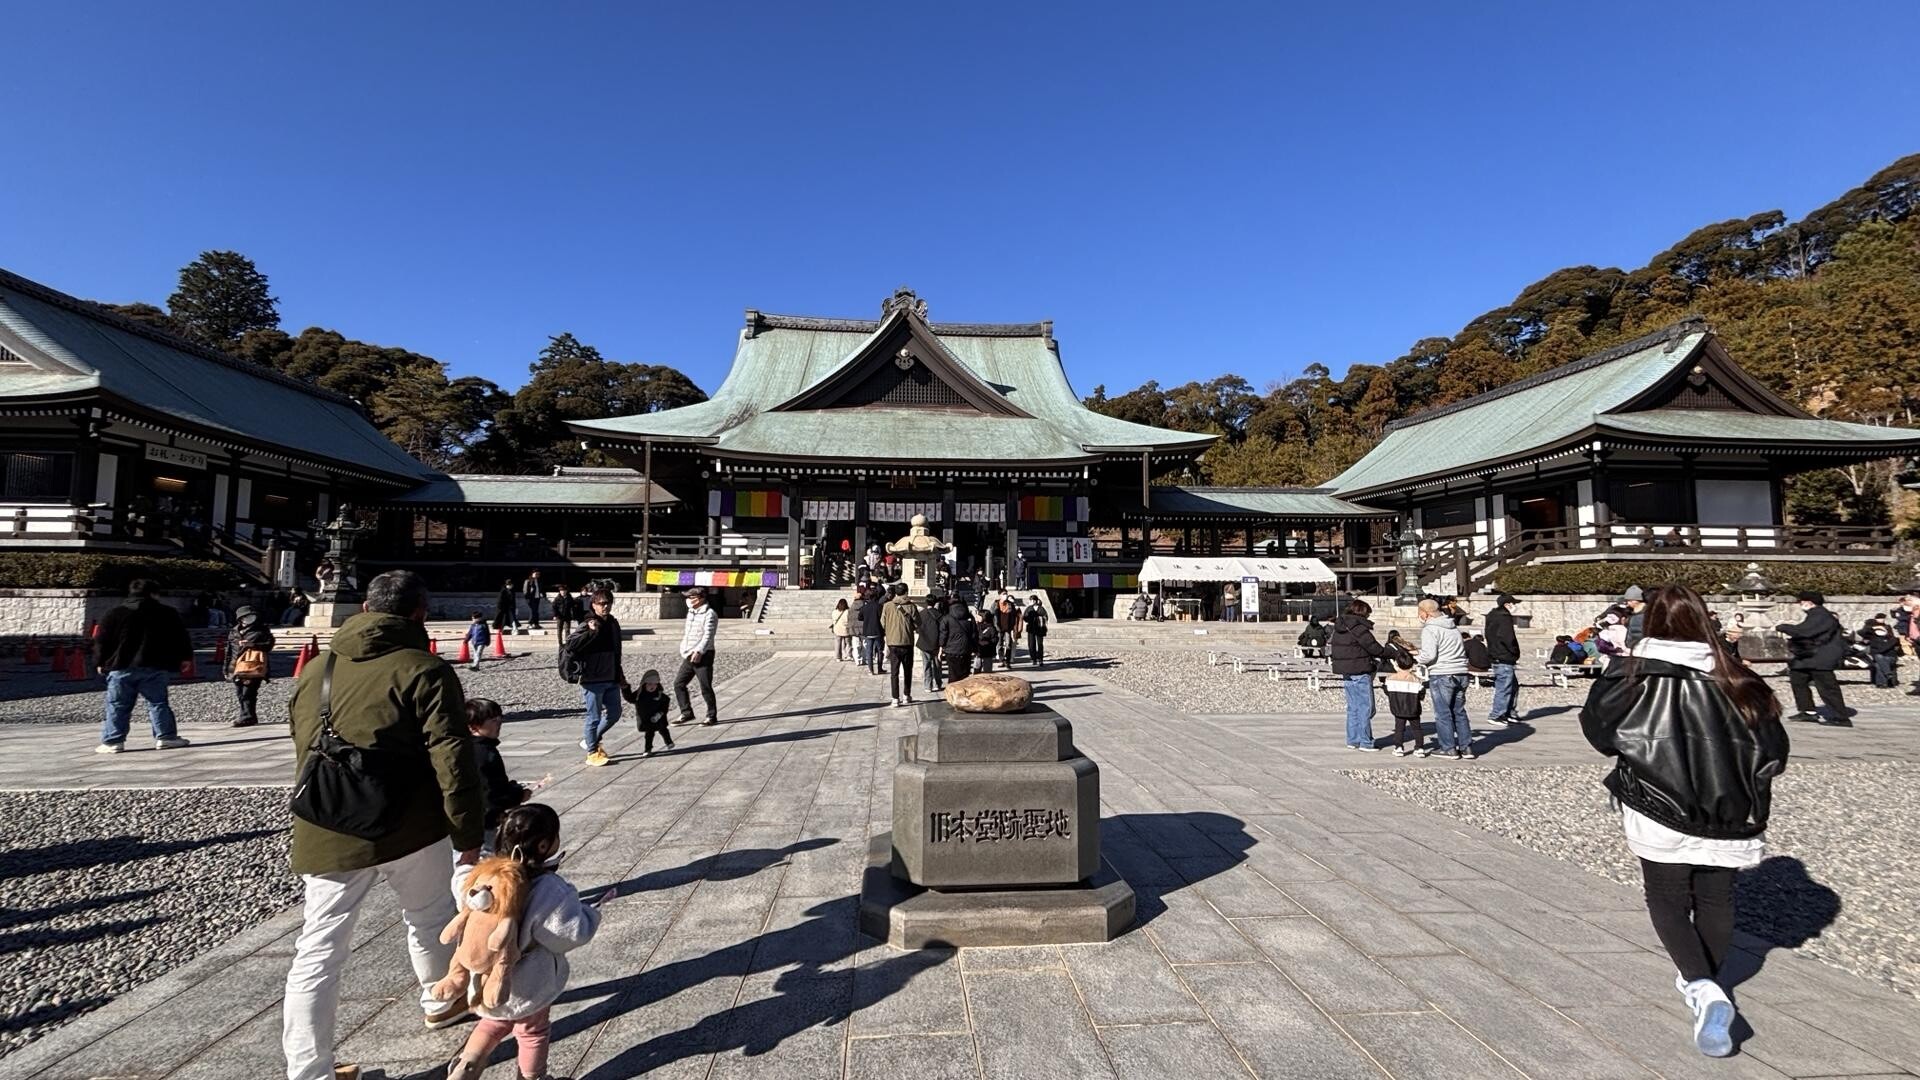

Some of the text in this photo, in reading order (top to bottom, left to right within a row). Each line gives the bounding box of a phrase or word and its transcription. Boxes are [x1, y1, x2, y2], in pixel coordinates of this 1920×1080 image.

[149, 447, 204, 466] お札・お守り
[930, 808, 1071, 843] 旧本堂跡聖地
